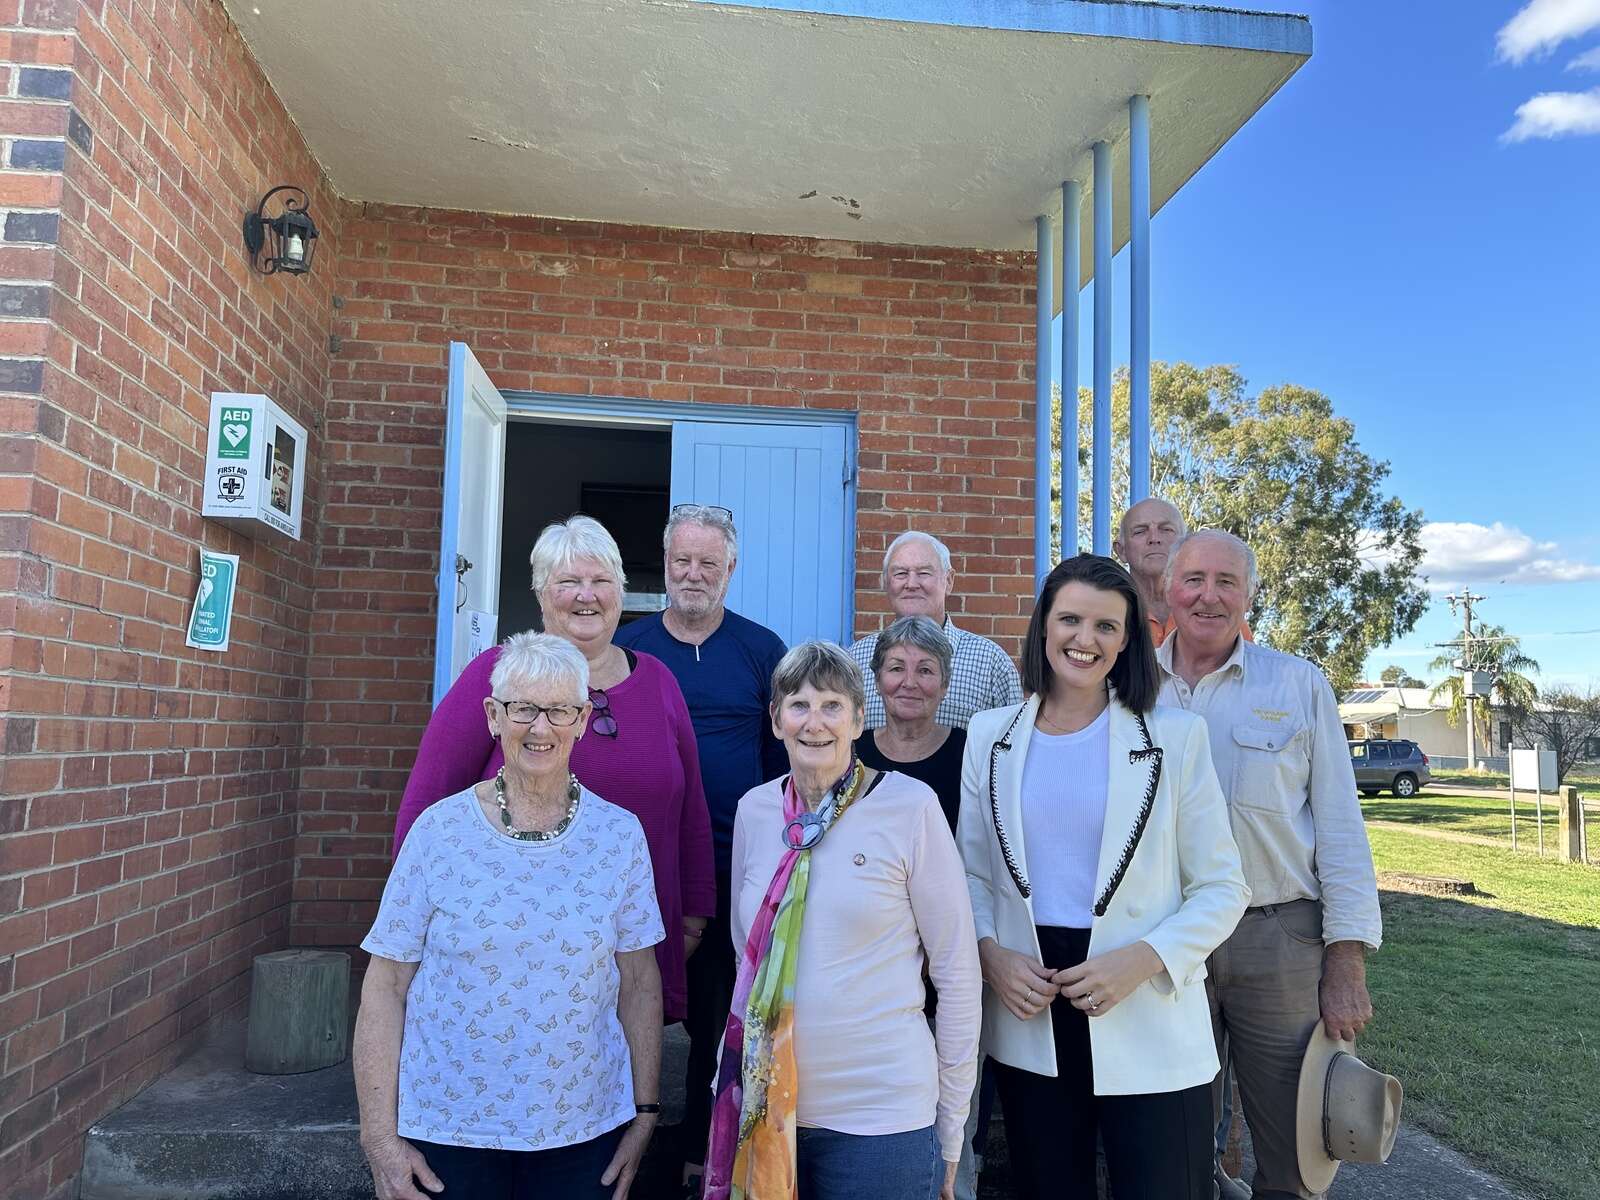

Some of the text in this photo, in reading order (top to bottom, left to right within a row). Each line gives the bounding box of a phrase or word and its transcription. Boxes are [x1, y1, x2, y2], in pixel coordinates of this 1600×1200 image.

[223, 410, 250, 421] AED
[217, 466, 248, 476] FIRST AID
